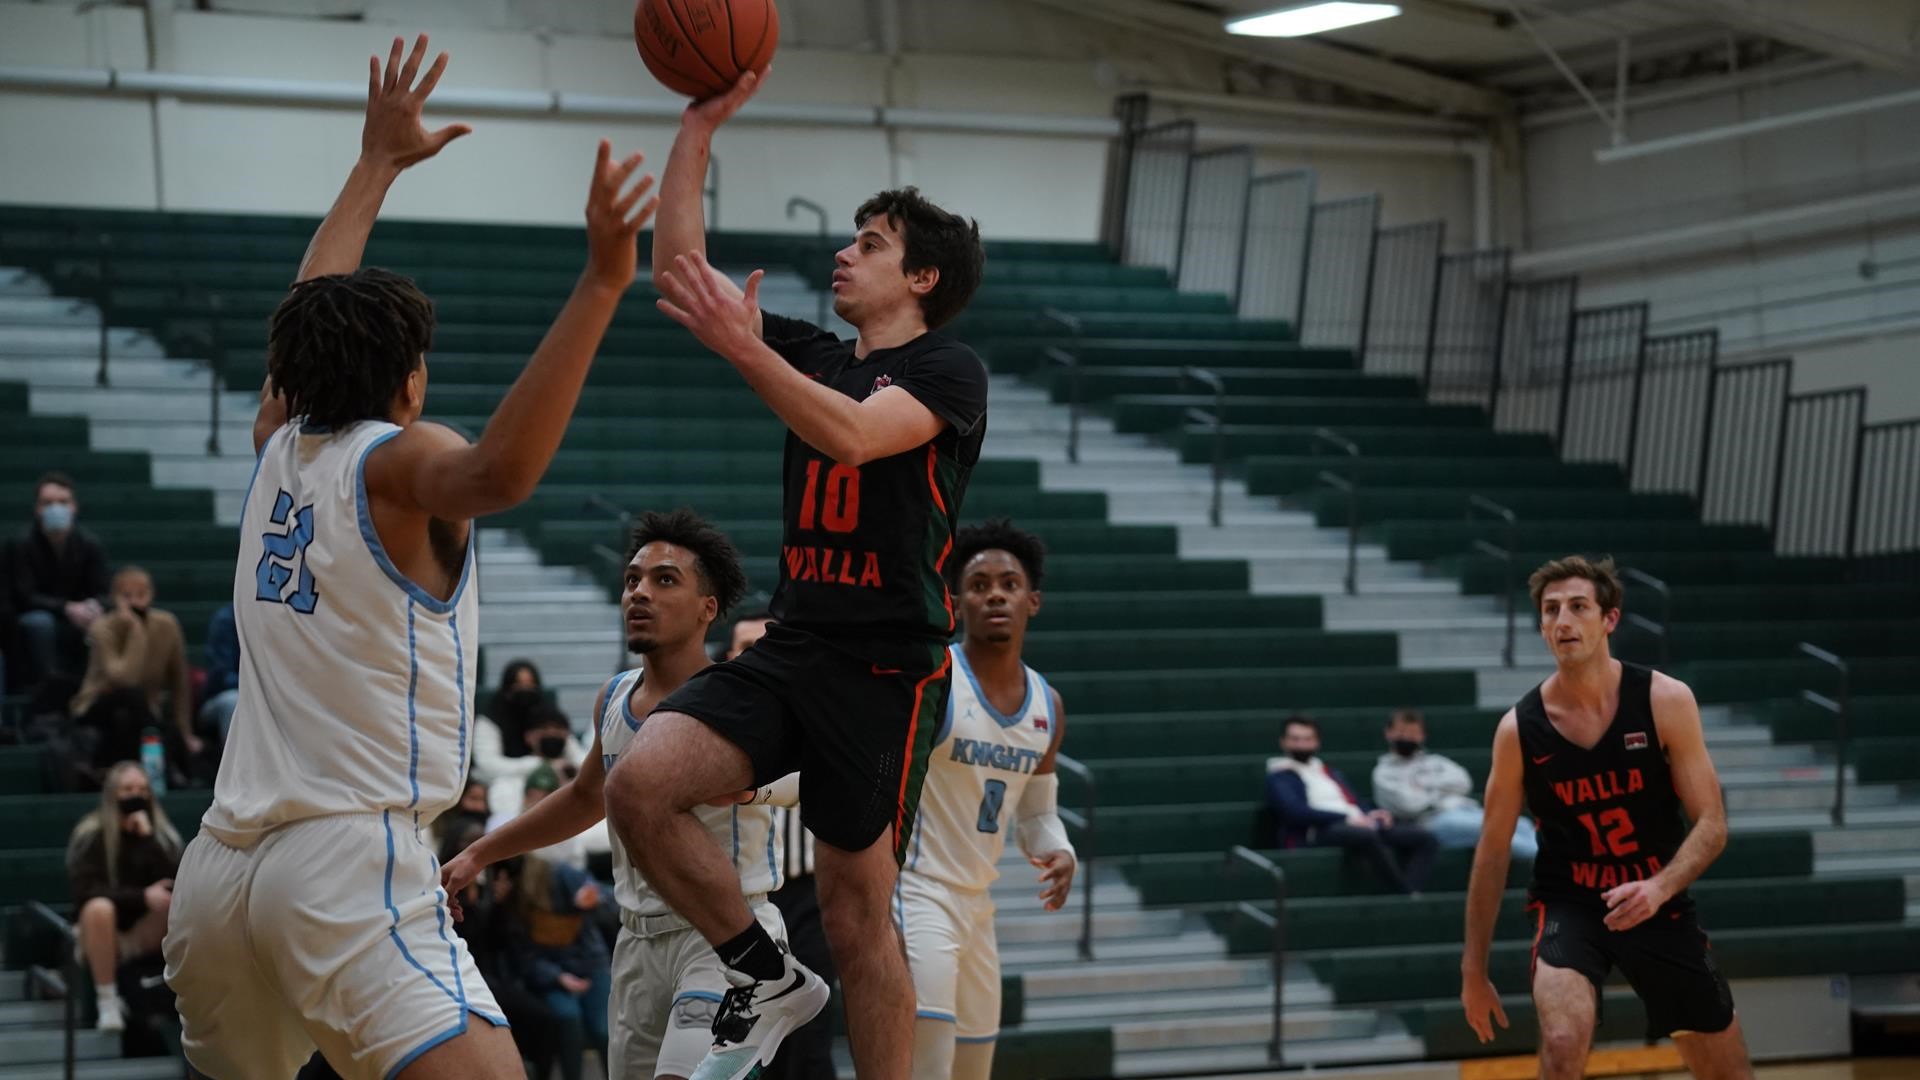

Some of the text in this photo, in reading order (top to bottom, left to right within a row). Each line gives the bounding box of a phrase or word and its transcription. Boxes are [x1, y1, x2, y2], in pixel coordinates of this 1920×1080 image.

[799, 460, 861, 533] 10
[256, 487, 320, 615] 21
[783, 545, 882, 588] WALLA
[1552, 768, 1645, 806] WALLA
[1577, 807, 1639, 857] 12
